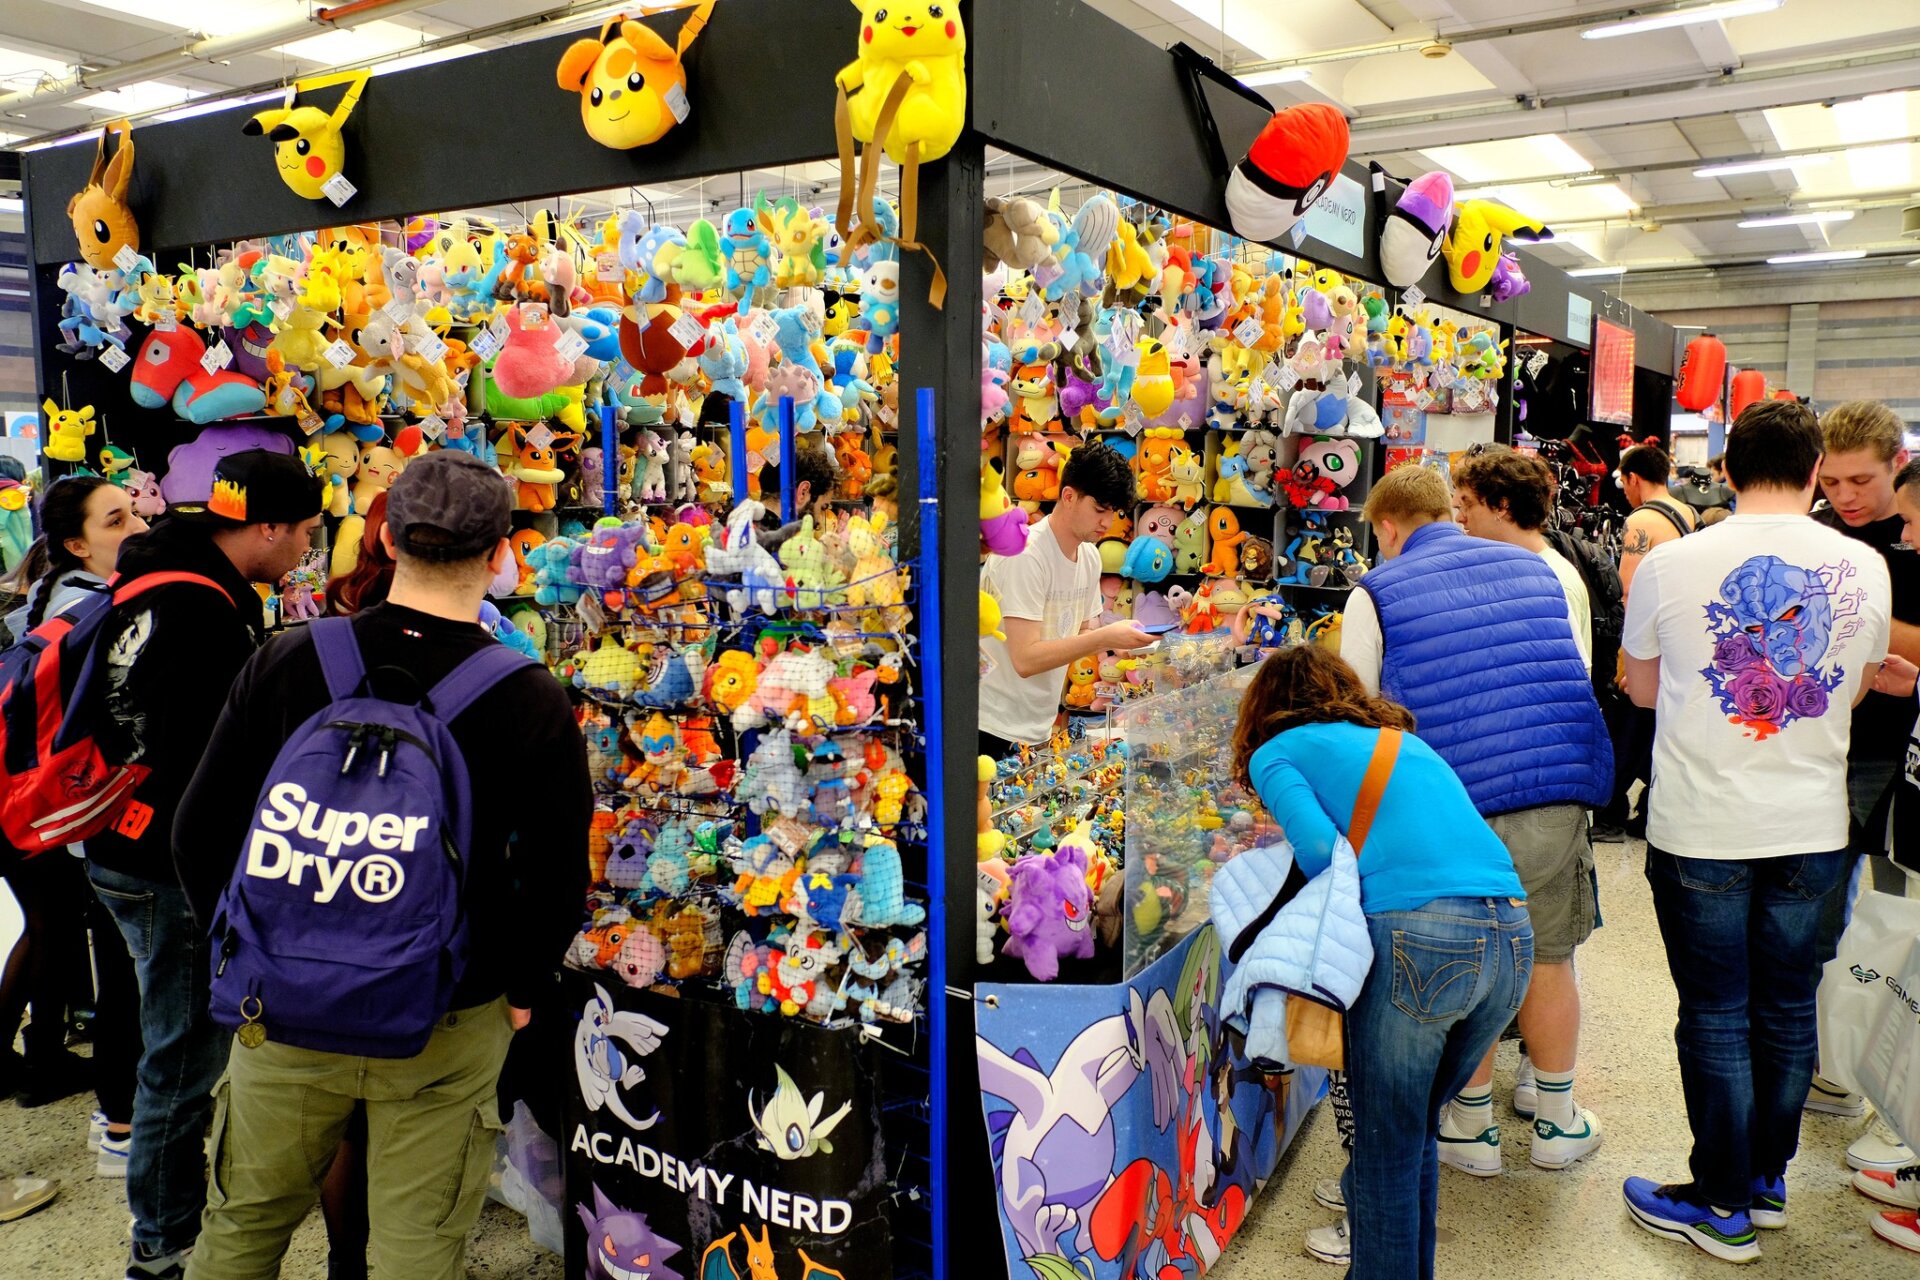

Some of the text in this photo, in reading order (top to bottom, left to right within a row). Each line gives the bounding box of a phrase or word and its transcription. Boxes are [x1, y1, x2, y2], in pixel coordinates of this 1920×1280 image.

[1315, 195, 1341, 218] CADEMY
[260, 782, 430, 857] Super
[571, 1124, 853, 1234] ACADEMY NERD
